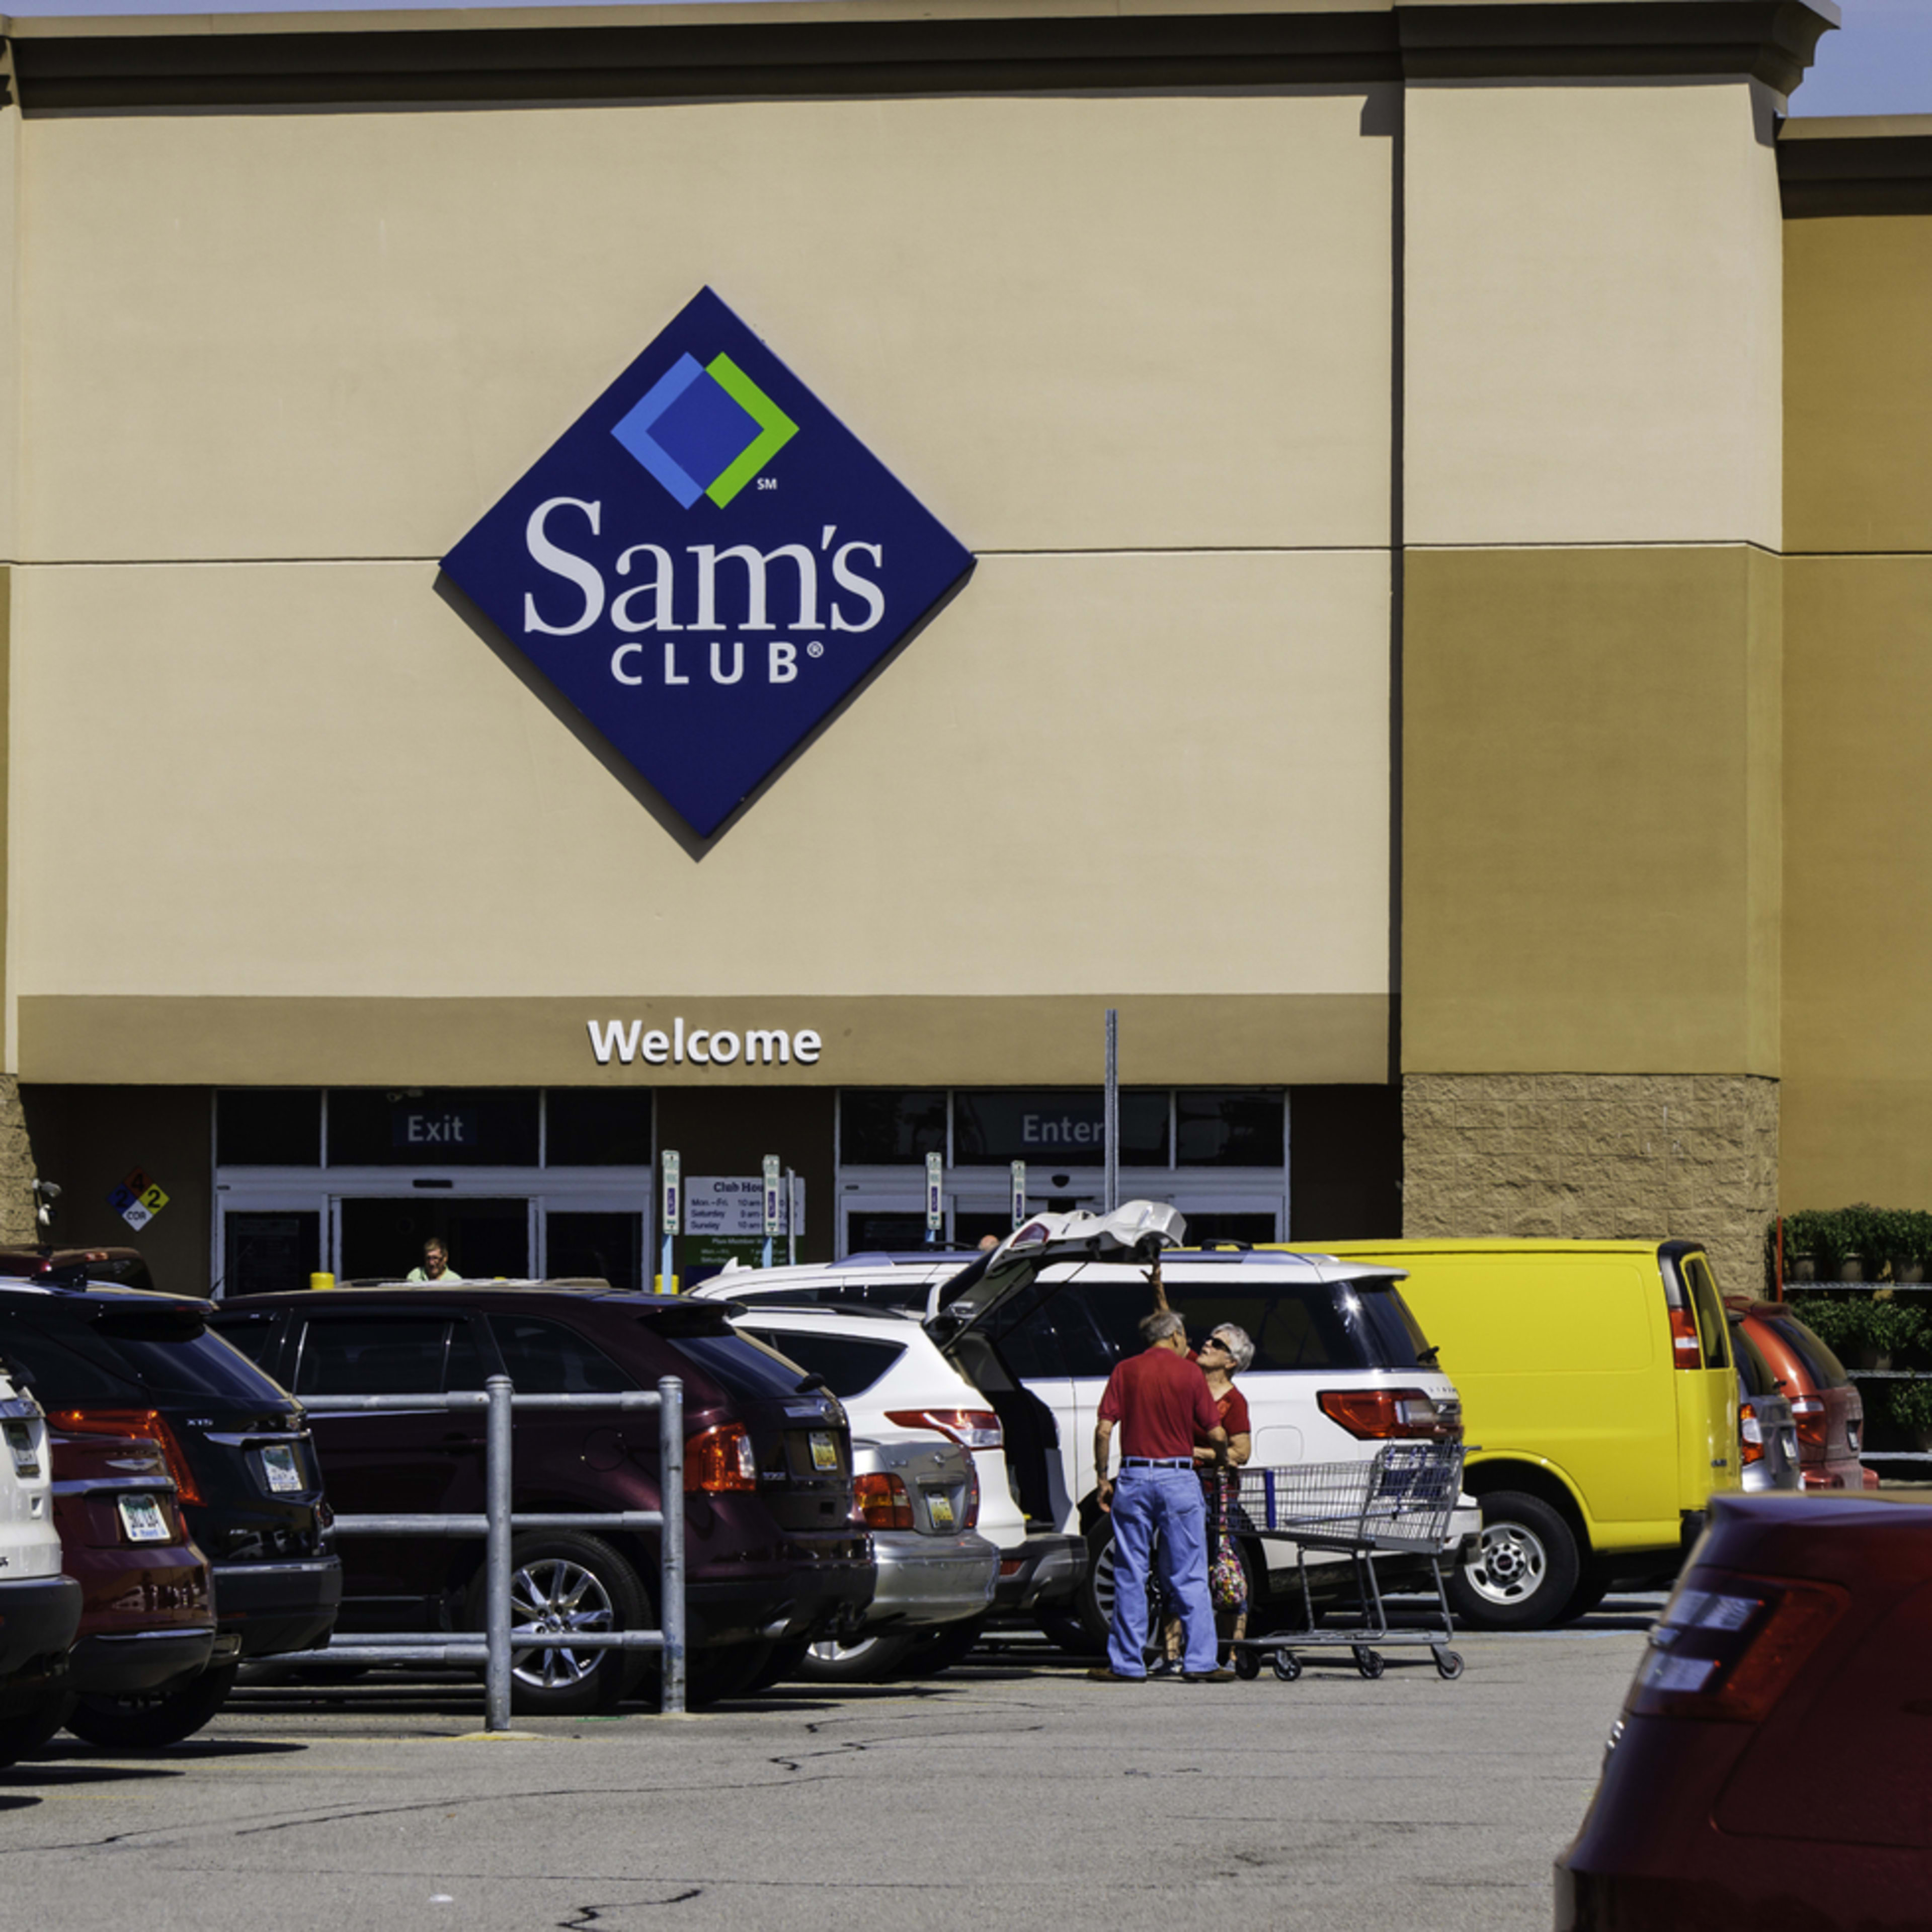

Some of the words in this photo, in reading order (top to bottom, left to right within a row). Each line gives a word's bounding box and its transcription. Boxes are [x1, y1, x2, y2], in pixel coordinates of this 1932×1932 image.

[524, 497, 884, 635] Sam's
[588, 1017, 822, 1063] Welcome
[408, 1115, 463, 1142] Exit
[1022, 1114, 1104, 1143] Enter
[131, 1173, 144, 1191] 4
[713, 1182, 739, 1192] Club
[741, 1182, 765, 1192] Hou
[116, 1189, 129, 1208] 2
[148, 1189, 160, 1208] 2
[691, 1210, 725, 1219] Saturday
[691, 1221, 720, 1230] Sunday
